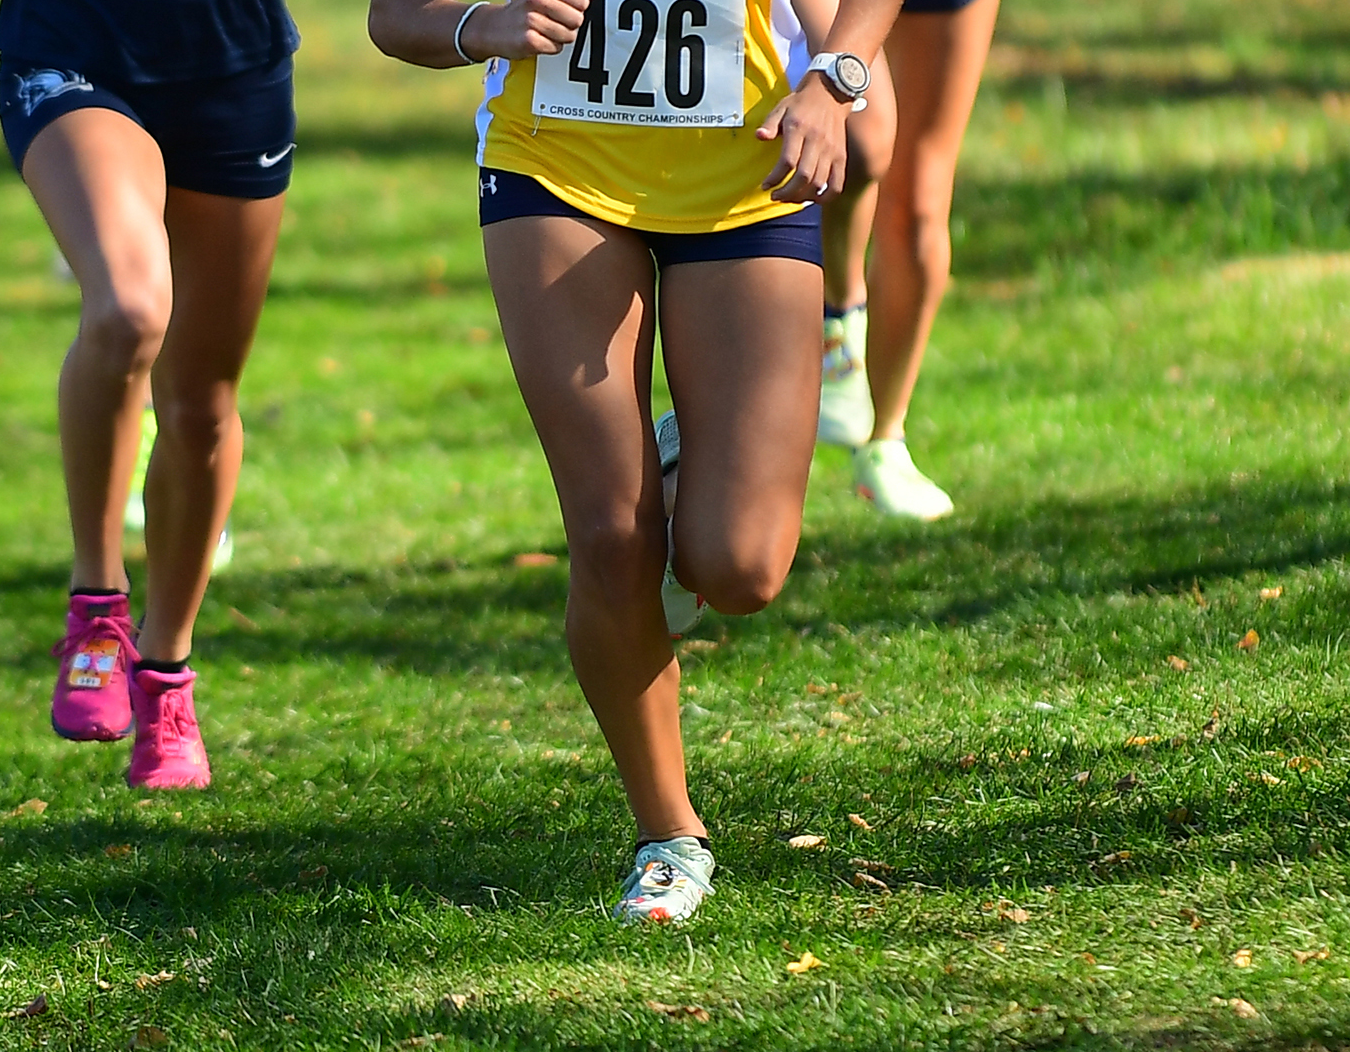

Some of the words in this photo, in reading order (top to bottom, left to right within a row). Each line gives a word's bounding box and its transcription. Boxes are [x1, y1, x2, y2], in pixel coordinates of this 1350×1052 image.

[550, 105, 584, 117] CROSS
[587, 110, 635, 122] COUNTRY
[638, 114, 723, 124] CHAMPIONSHIPS
